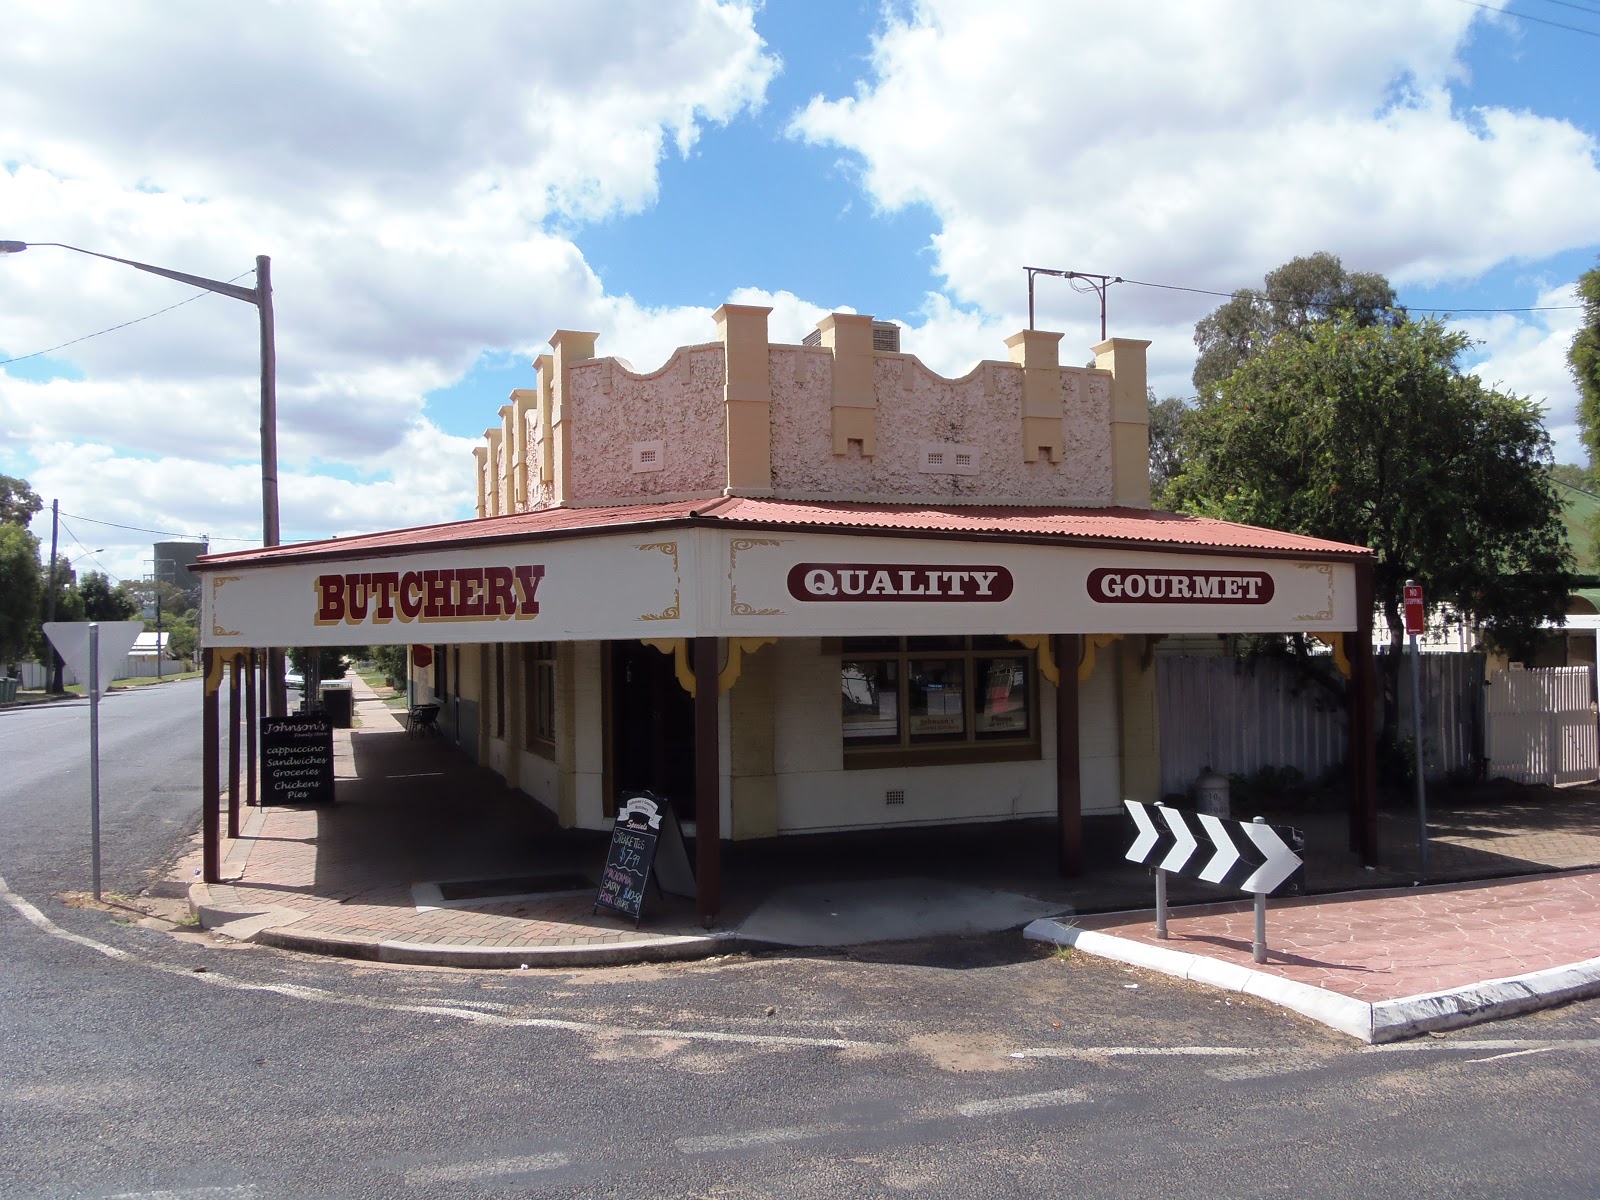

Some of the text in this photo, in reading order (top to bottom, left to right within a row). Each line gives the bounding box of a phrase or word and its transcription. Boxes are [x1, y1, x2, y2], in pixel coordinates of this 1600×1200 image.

[803, 569, 1262, 599] QUALITY GOURMET
[315, 565, 546, 625] BUTCHERY
[264, 721, 327, 735] Johnson's
[266, 745, 327, 756] cappuccino
[267, 756, 328, 767] Sandwiches
[272, 768, 321, 778] Groceries
[274, 780, 321, 790] Chickens
[287, 791, 310, 799] Pies
[626, 819, 648, 831] Specials
